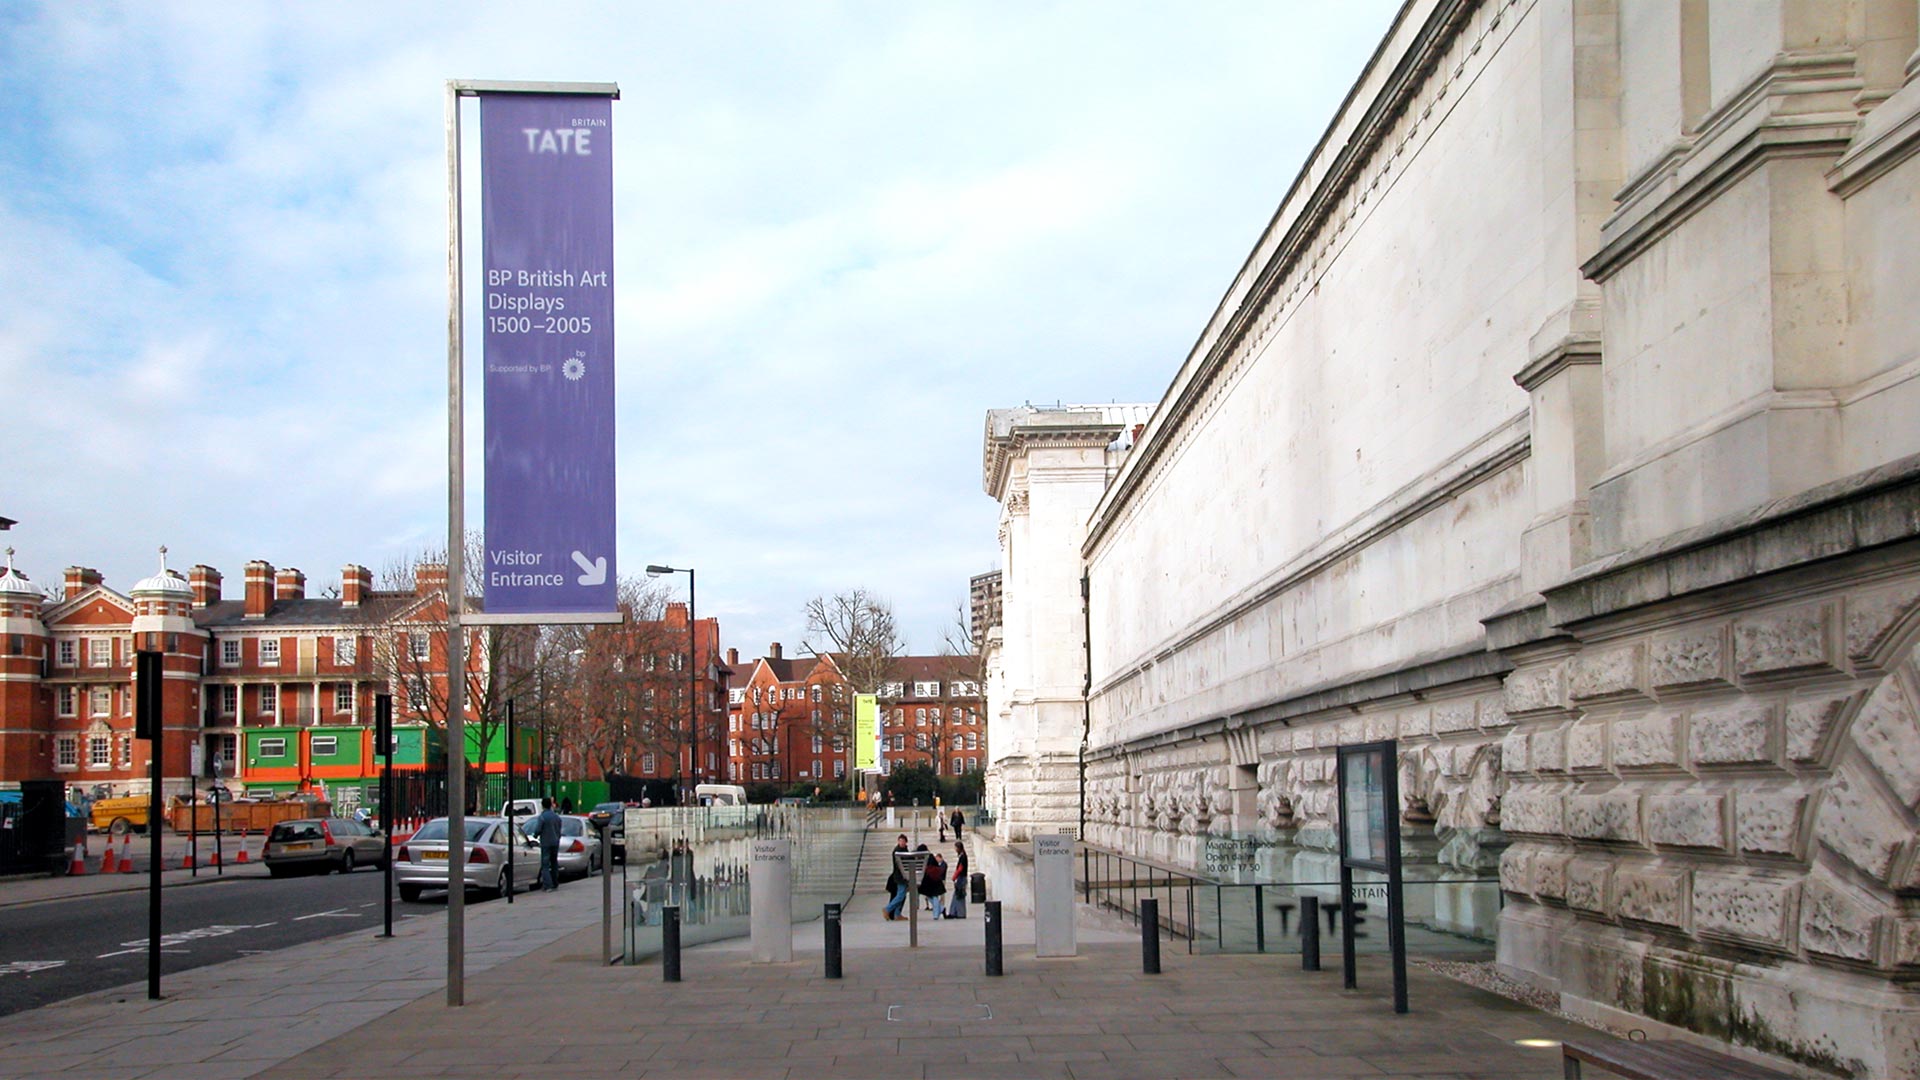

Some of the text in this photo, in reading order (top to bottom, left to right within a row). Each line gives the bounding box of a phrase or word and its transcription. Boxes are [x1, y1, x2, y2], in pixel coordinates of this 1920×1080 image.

[572, 118, 606, 127] BRITAIN
[523, 128, 592, 155] TATE
[489, 270, 608, 287] BP British Art
[489, 293, 564, 313] Displays
[489, 364, 551, 374] Supported by BP
[490, 550, 543, 565] Visitor
[491, 571, 564, 587] Entrance
[1038, 848, 1070, 856] Entrance
[754, 854, 785, 862] Entrance
[1206, 853, 1230, 862] Open
[1348, 888, 1389, 898] RITAIN
